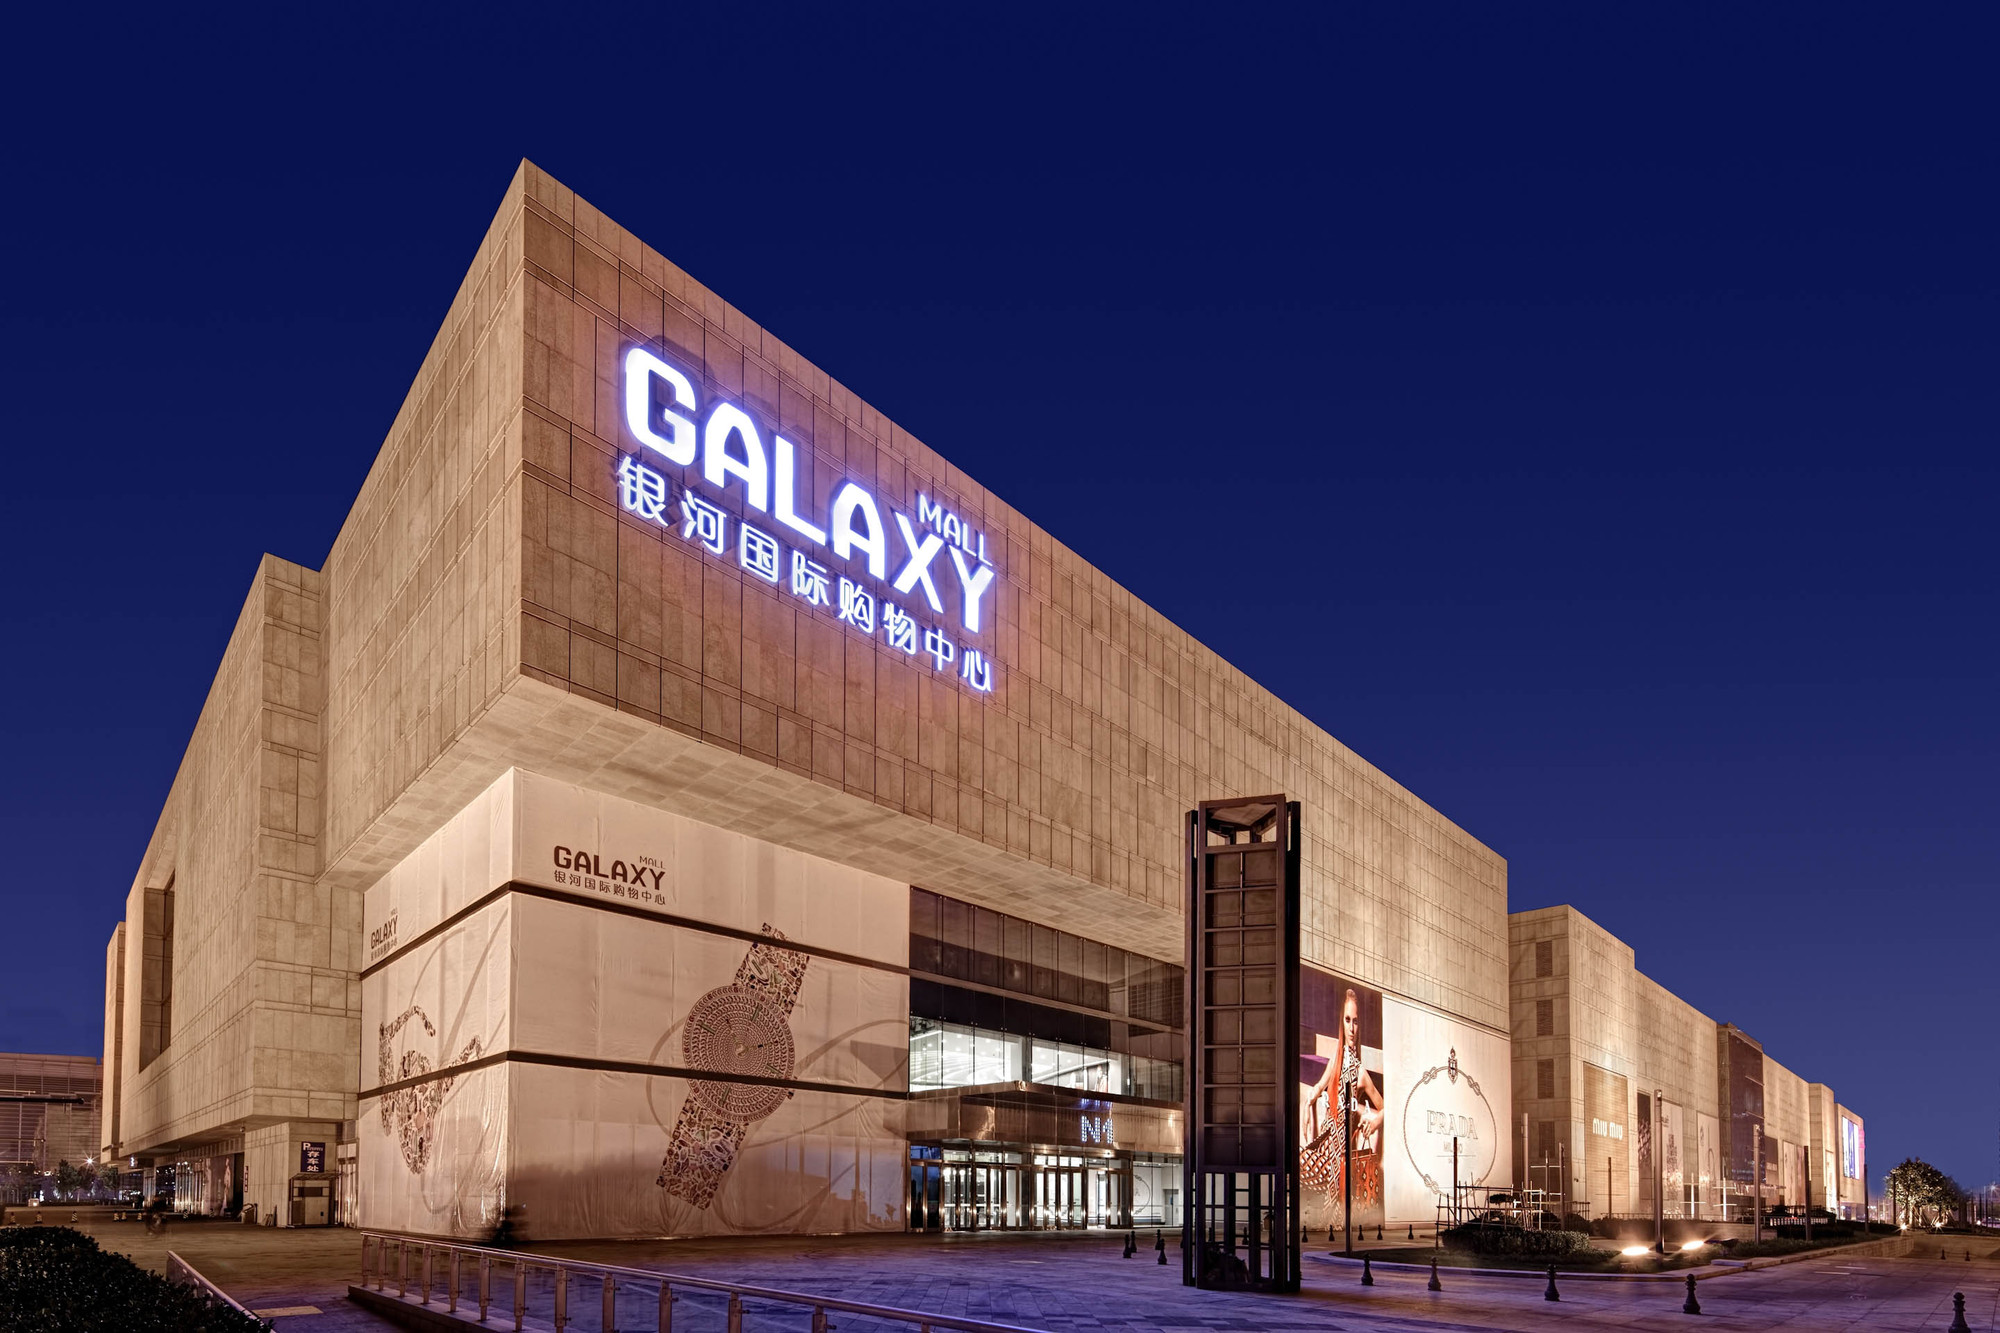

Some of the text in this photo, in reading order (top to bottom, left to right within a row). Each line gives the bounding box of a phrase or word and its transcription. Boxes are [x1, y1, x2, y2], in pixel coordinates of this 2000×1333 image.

[625, 347, 995, 633] GALAXY
[918, 493, 993, 567] MALL
[617, 455, 992, 692] 银河国际购物中心
[553, 845, 666, 891] GALAXY
[639, 855, 666, 869] MALL
[554, 869, 666, 906] 银河国际购物中心
[370, 914, 398, 949] GALAXY
[1081, 1115, 1113, 1144] N1
[1426, 1109, 1479, 1140] PRADA
